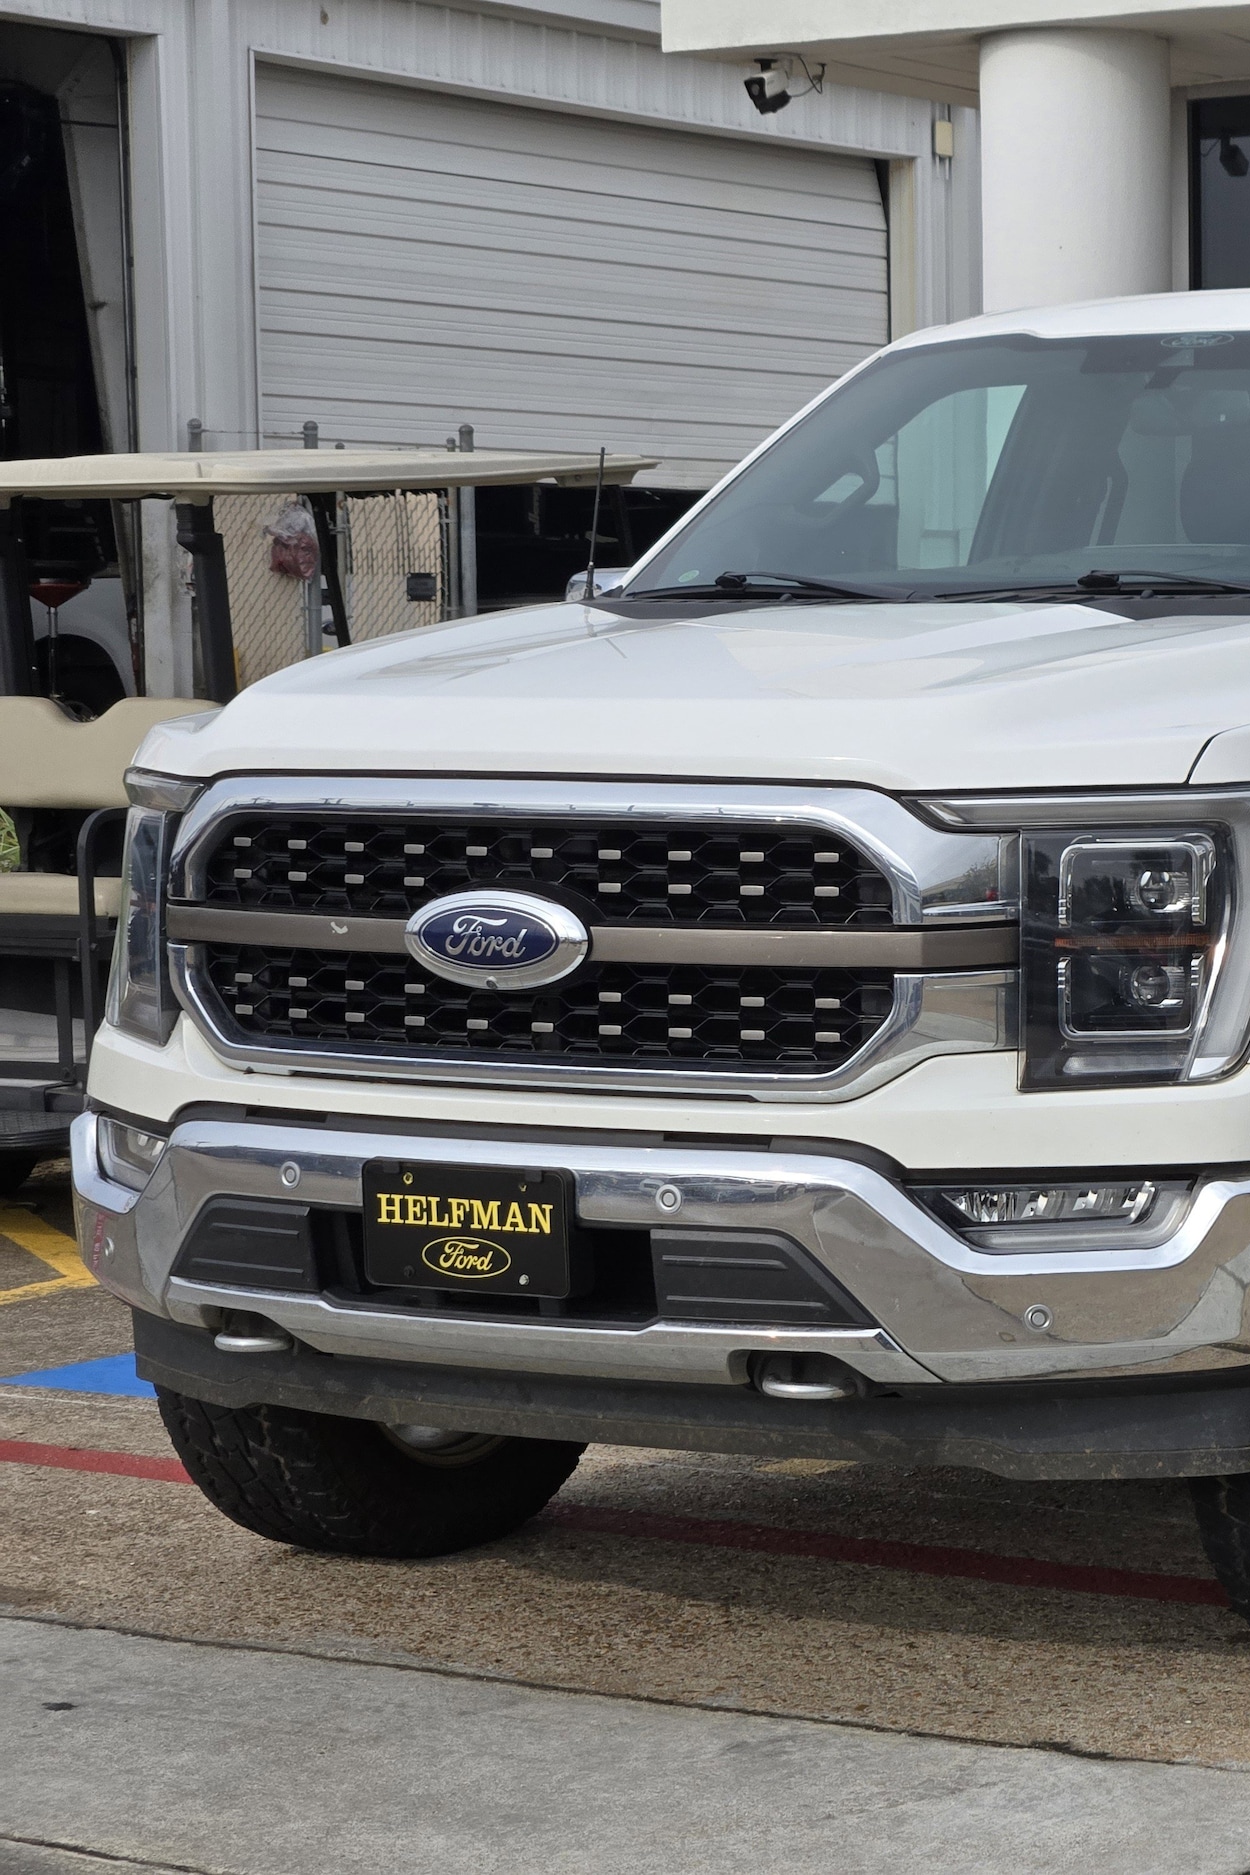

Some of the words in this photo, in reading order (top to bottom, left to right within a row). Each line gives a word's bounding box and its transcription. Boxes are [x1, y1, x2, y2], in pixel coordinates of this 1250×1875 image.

[445, 914, 528, 959] Ford
[376, 1193, 554, 1234] HELFMAN
[439, 1240, 494, 1271] Ford
